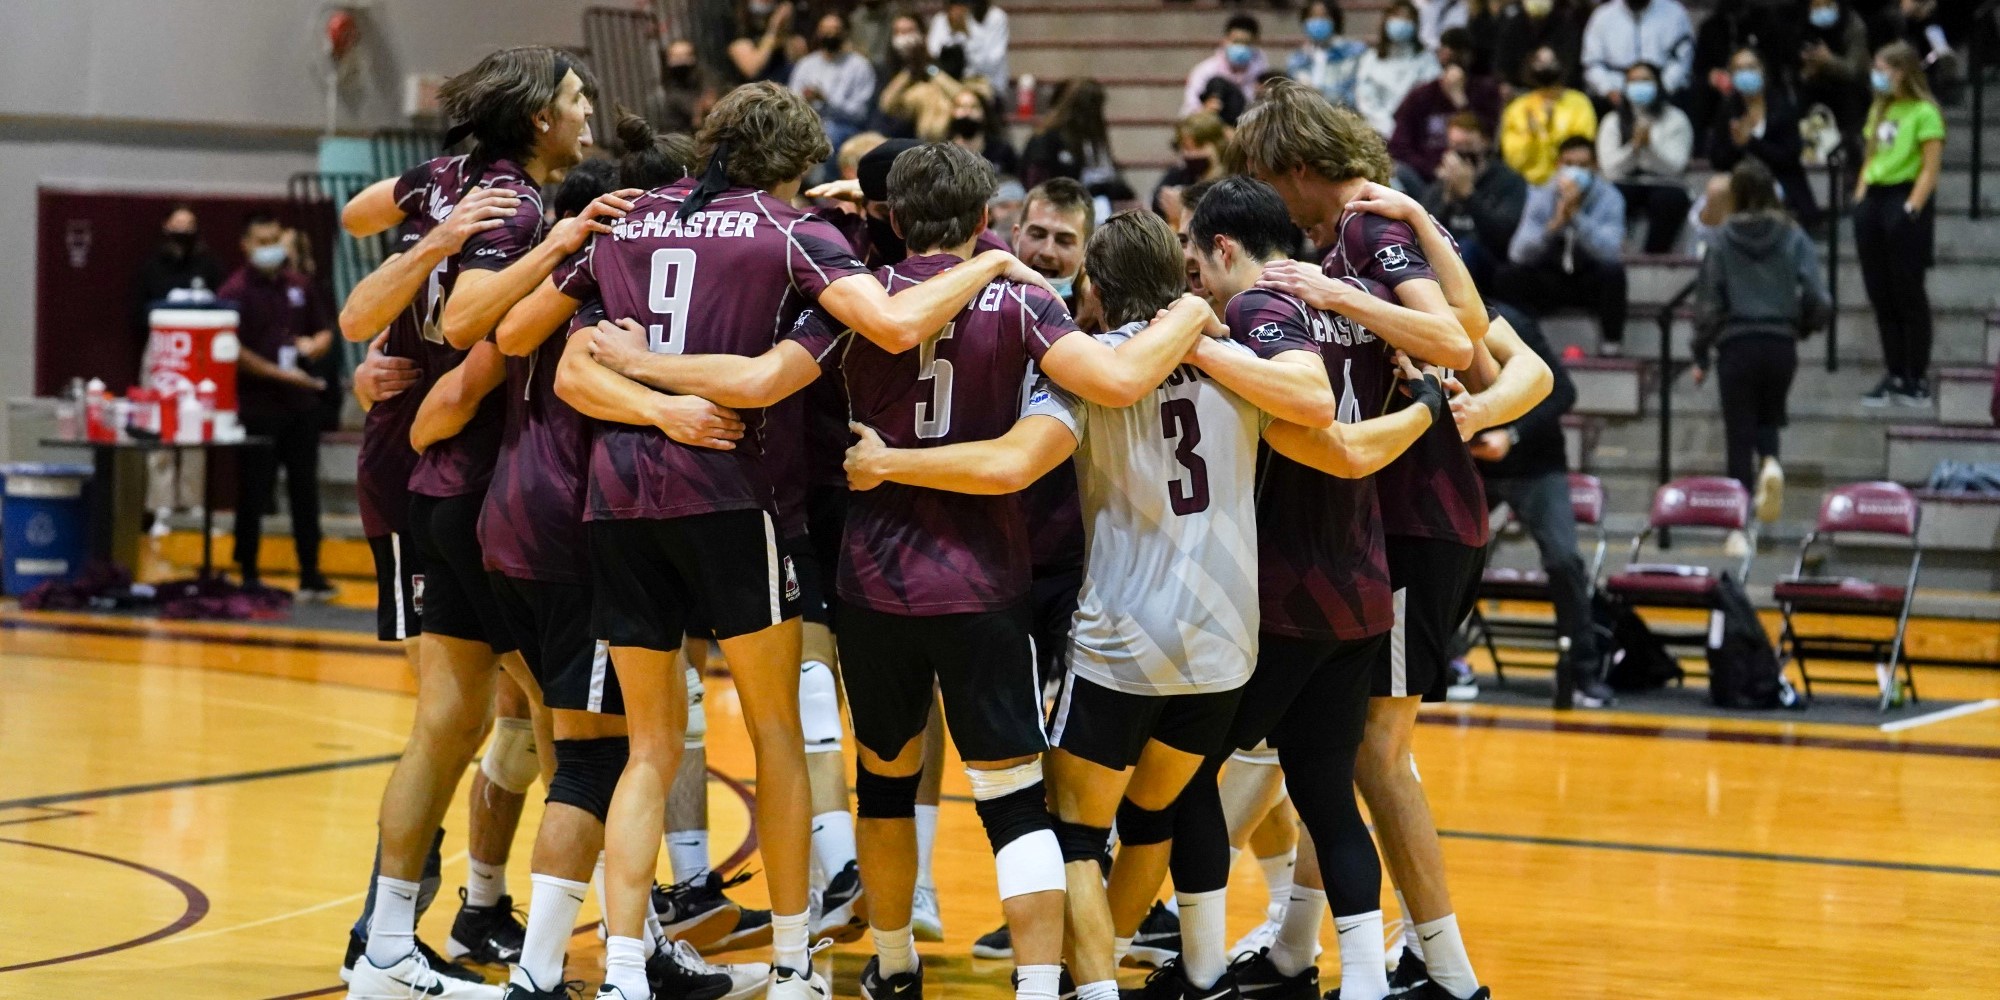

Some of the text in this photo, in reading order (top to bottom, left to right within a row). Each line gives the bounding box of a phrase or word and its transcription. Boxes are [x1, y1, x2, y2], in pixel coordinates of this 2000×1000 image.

[611, 211, 758, 241] McMASTER
[649, 248, 697, 355] 9
[915, 321, 954, 439] 5
[1161, 398, 1210, 516] 3
